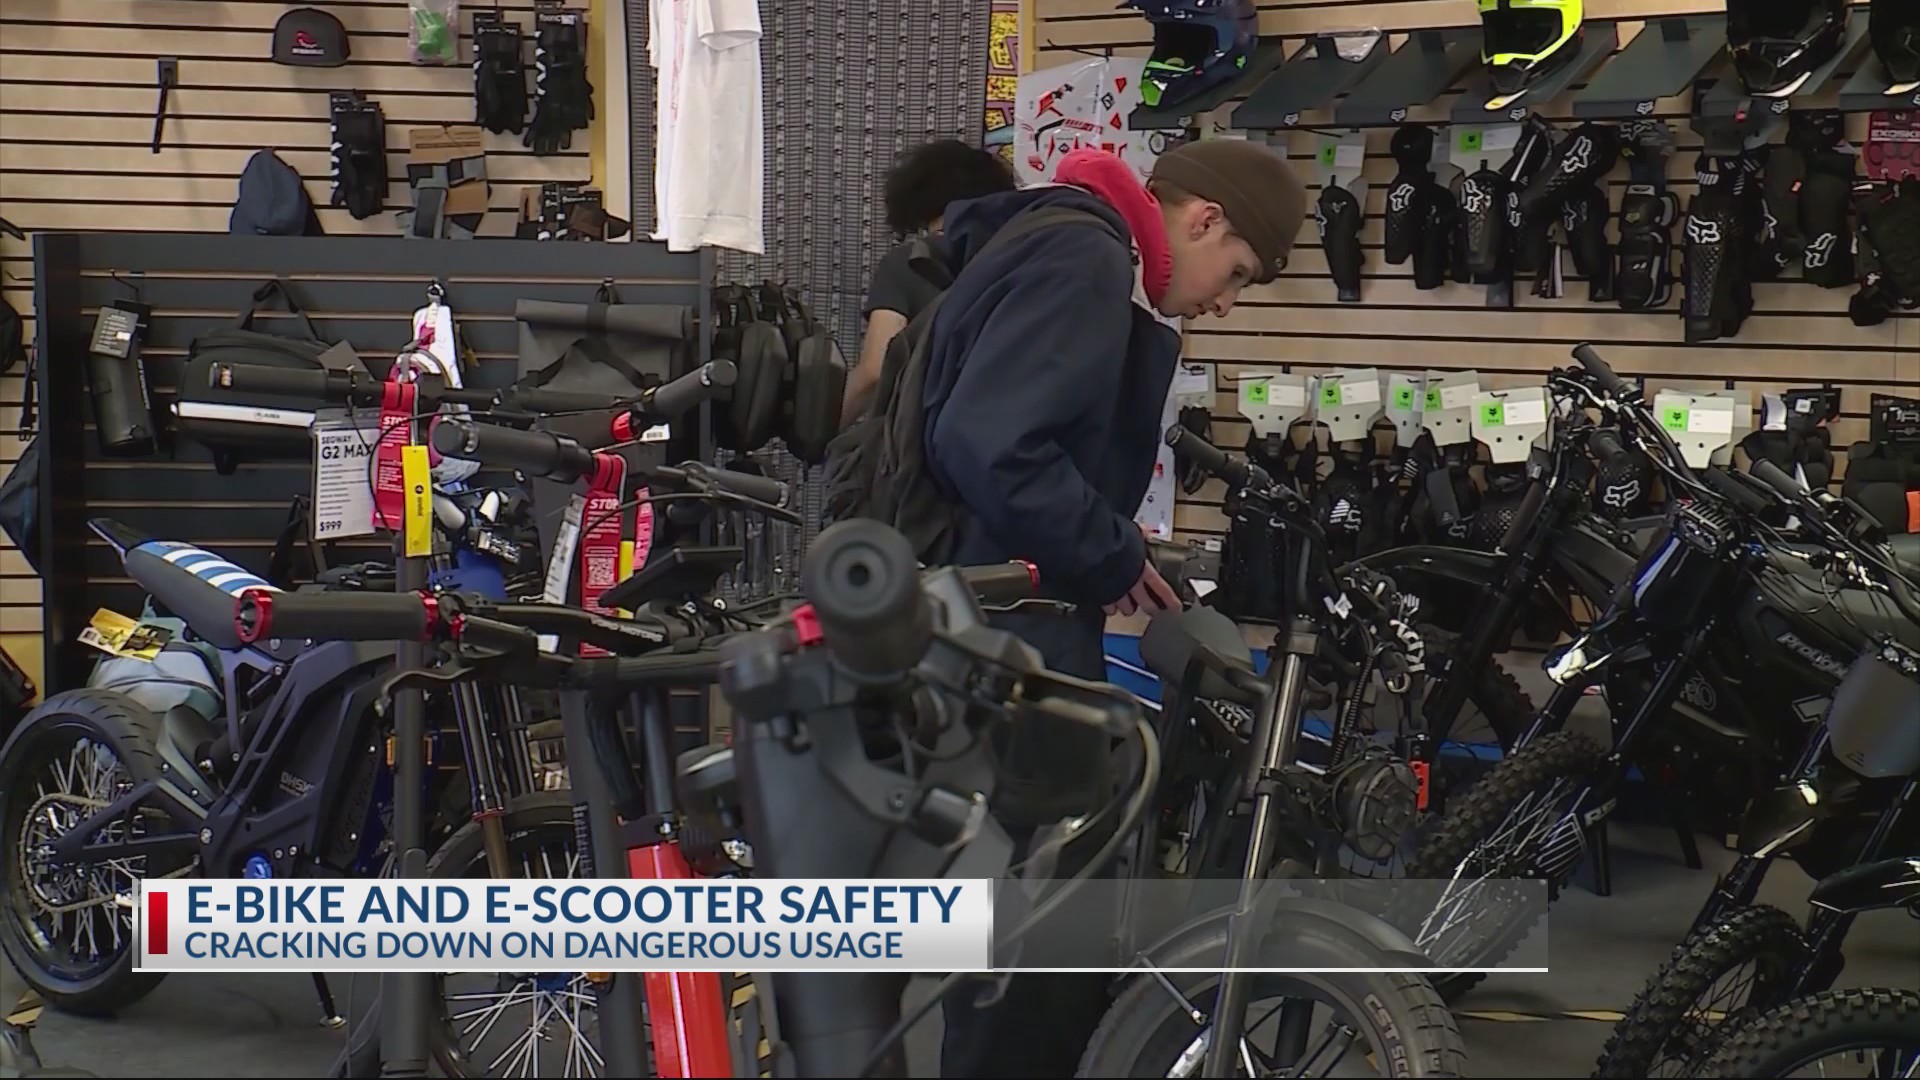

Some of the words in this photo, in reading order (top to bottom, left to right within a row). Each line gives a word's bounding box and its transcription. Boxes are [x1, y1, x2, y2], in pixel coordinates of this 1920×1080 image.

[321, 435, 352, 444] SEGWAY
[321, 446, 340, 460] G2
[343, 444, 374, 459] MAX
[589, 498, 620, 510] STOP
[319, 520, 343, 532] $999
[1363, 993, 1401, 1042] CST
